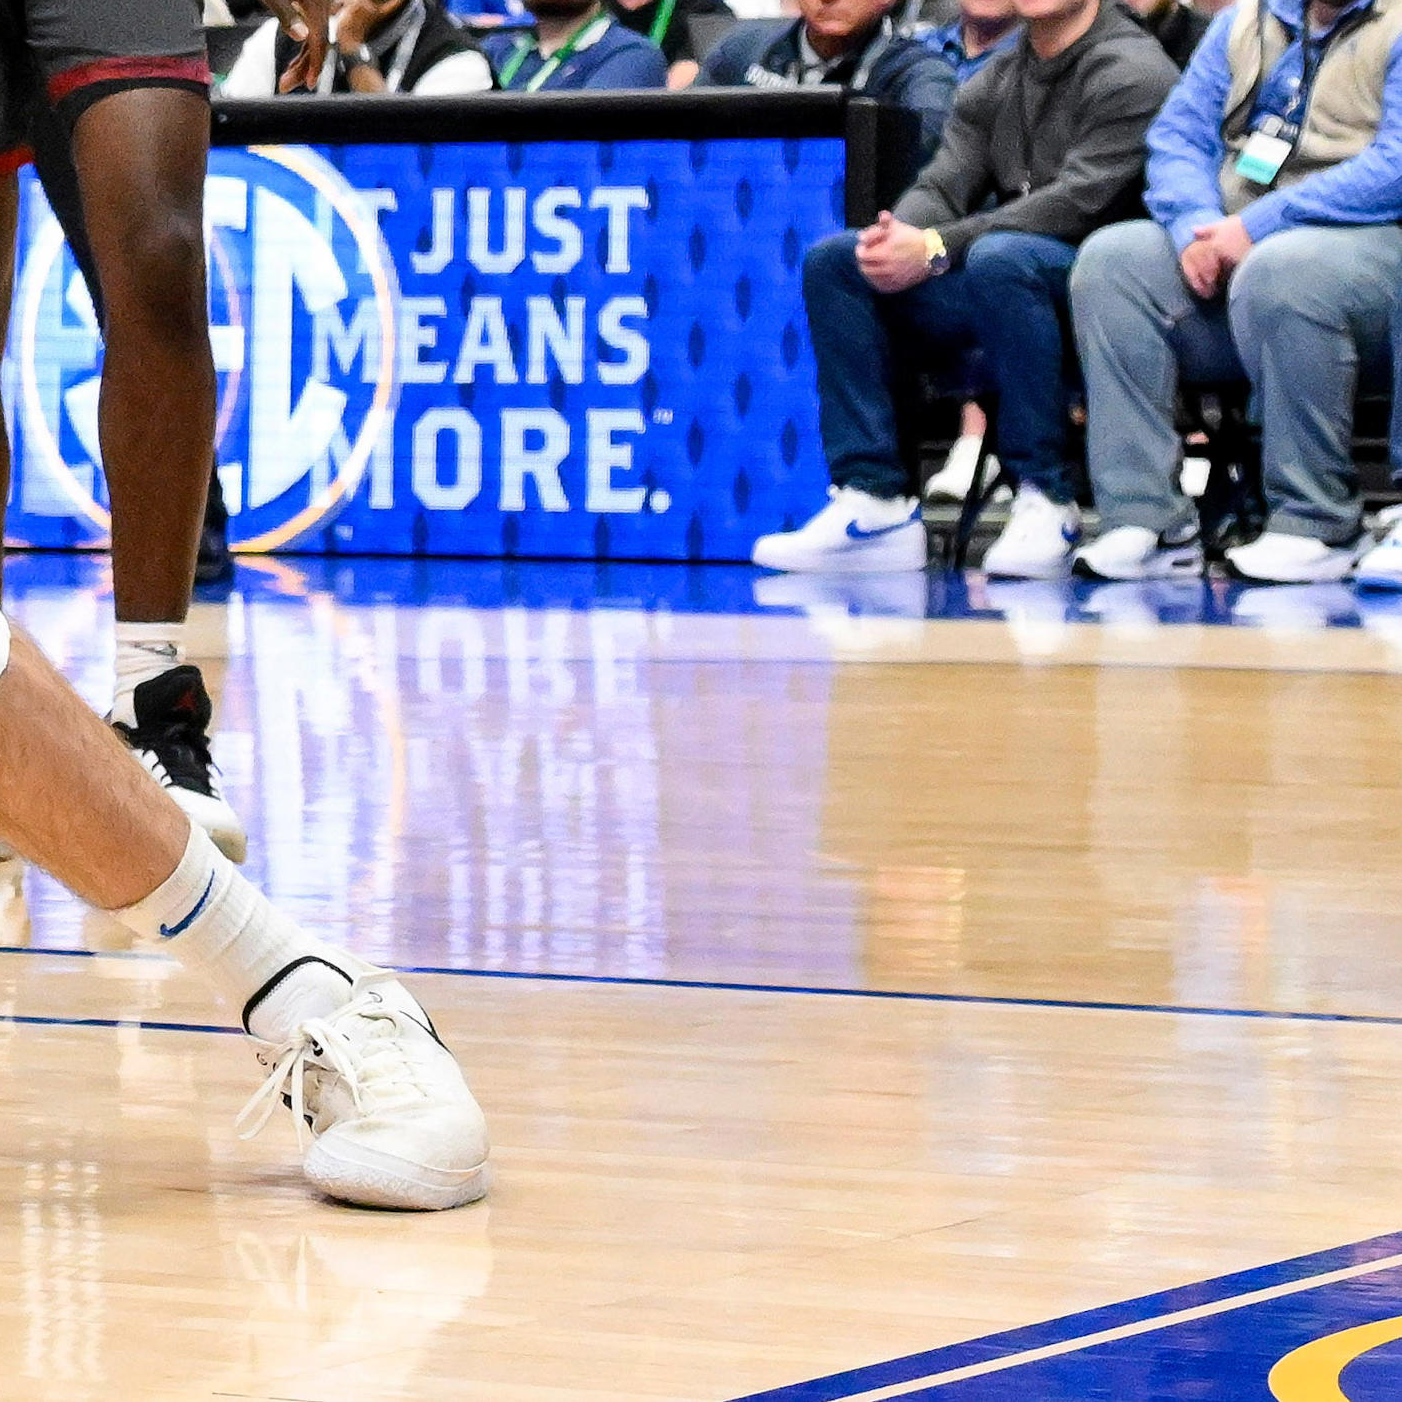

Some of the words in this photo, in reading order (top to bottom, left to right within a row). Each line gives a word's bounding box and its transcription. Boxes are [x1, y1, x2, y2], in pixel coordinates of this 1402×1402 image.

[409, 186, 650, 274] JUST
[310, 295, 652, 385] MEANS
[309, 407, 671, 514] MORE.
